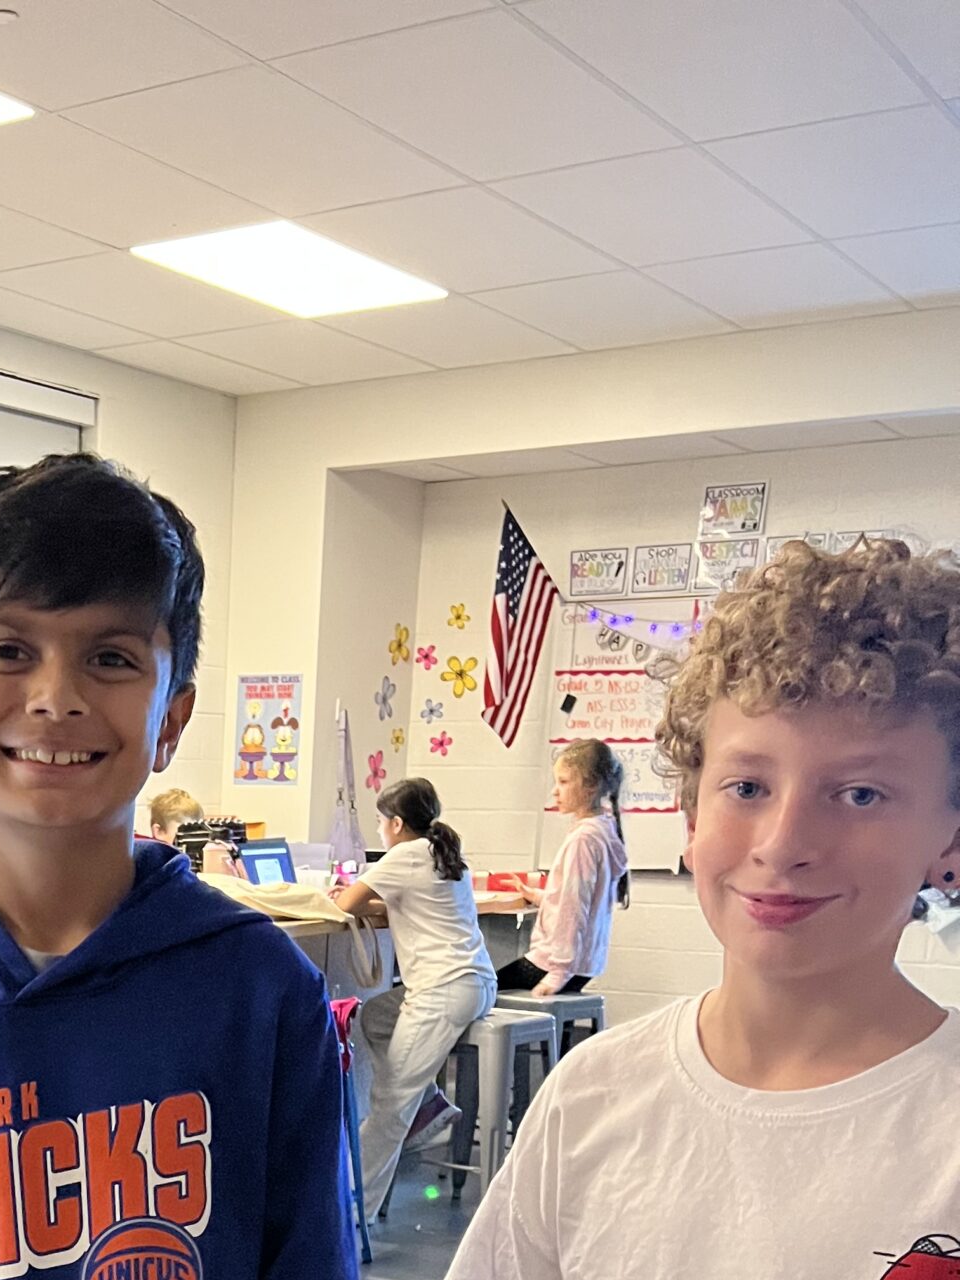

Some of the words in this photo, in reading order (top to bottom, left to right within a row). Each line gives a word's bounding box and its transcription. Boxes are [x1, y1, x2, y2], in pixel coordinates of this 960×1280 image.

[701, 540, 756, 560] RESPECT
[571, 560, 613, 579] READY
[647, 568, 688, 586] LISTEN
